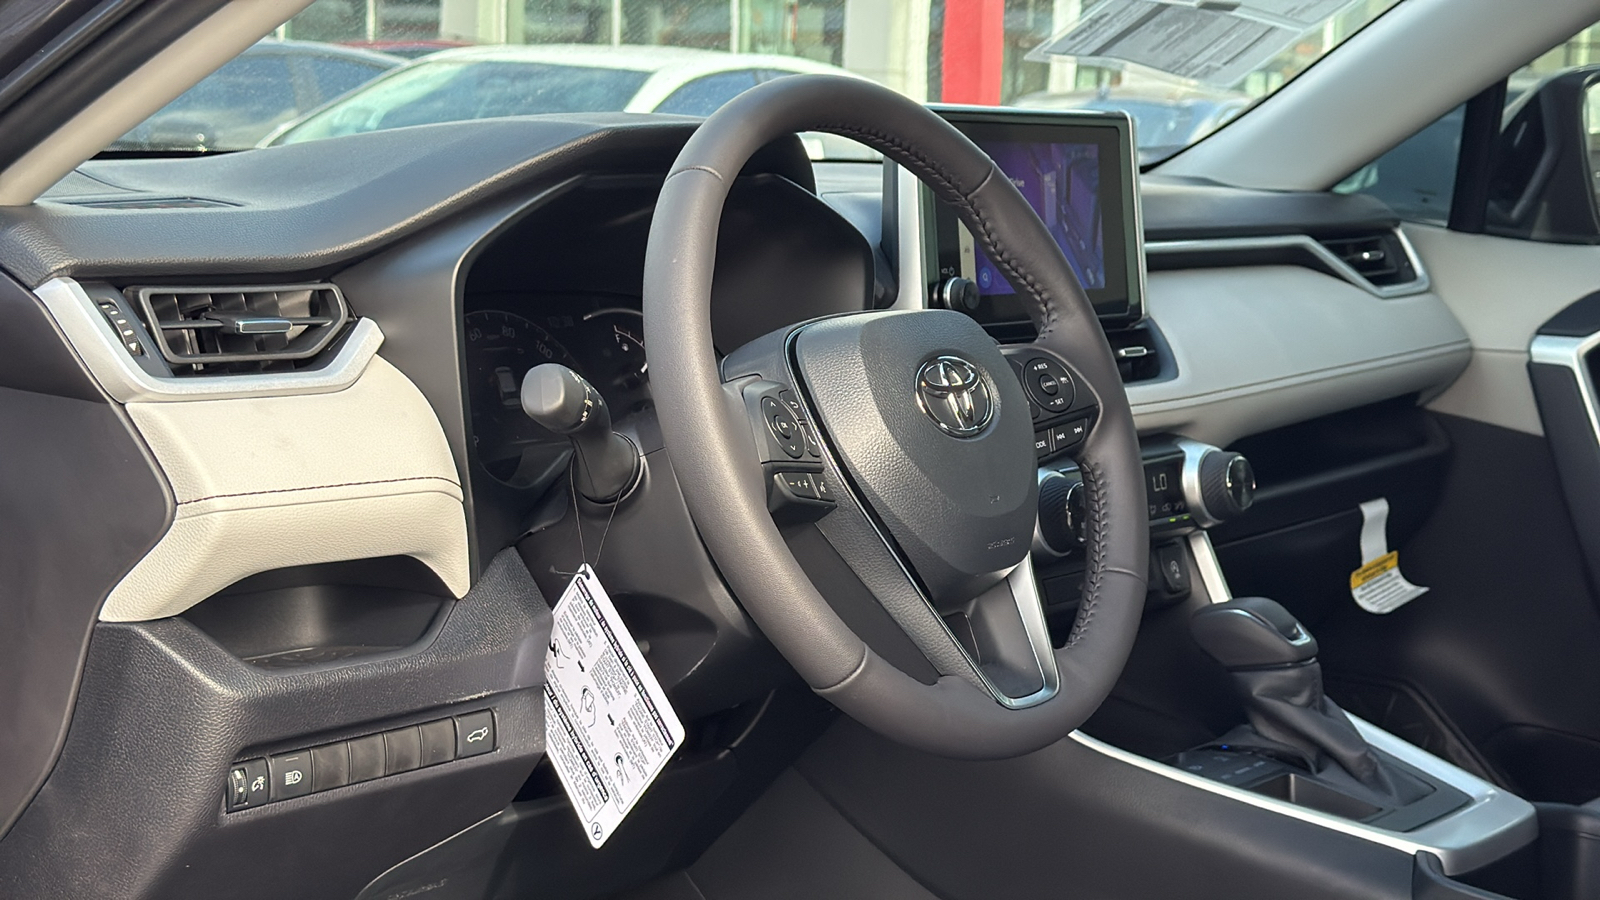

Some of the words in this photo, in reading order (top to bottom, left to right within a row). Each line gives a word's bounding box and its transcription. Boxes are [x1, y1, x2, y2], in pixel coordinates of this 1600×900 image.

[469, 327, 482, 342] 60
[502, 325, 516, 338] 80
[536, 340, 553, 359] 100
